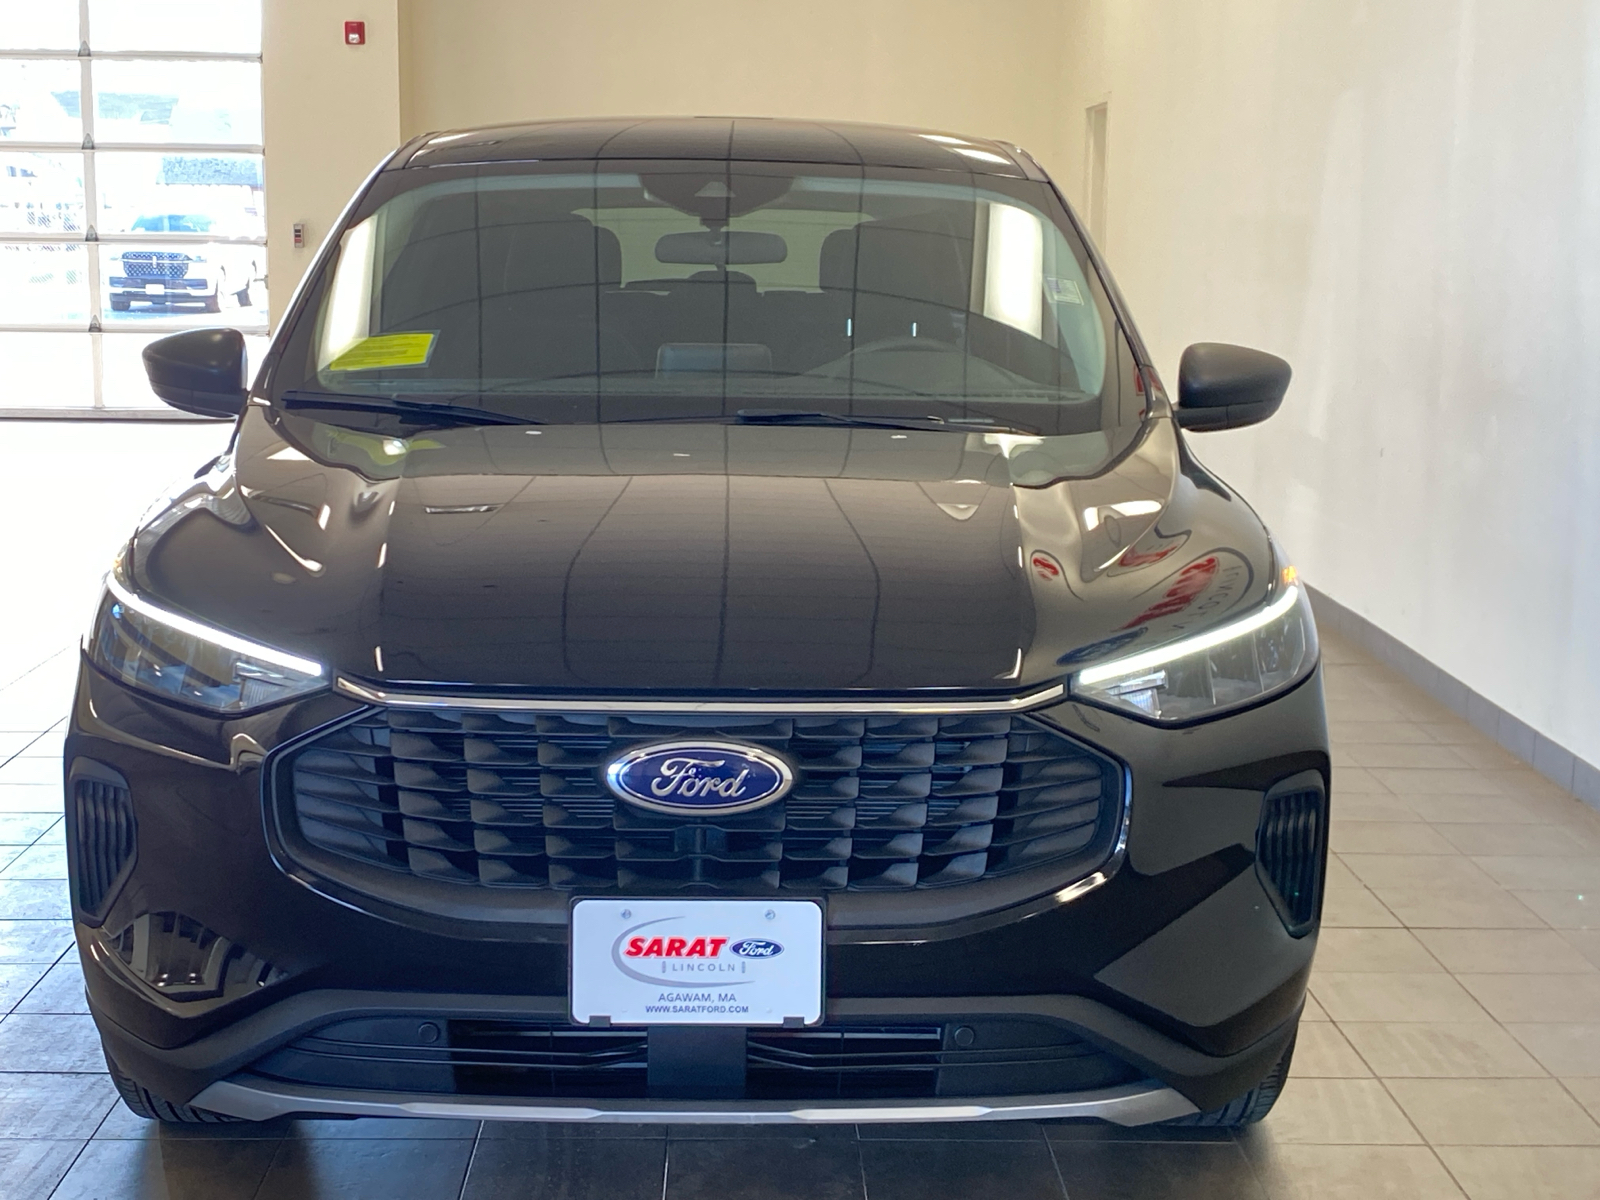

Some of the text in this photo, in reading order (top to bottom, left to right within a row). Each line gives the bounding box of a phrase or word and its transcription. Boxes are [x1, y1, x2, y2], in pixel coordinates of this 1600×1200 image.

[651, 757, 750, 797] Ford
[625, 937, 774, 957] SARAT Ford
[672, 963, 735, 972] LINCOLN
[658, 993, 736, 1003] AGAWAM, MA
[645, 1005, 749, 1013] WWW.SARATFORD.COM
